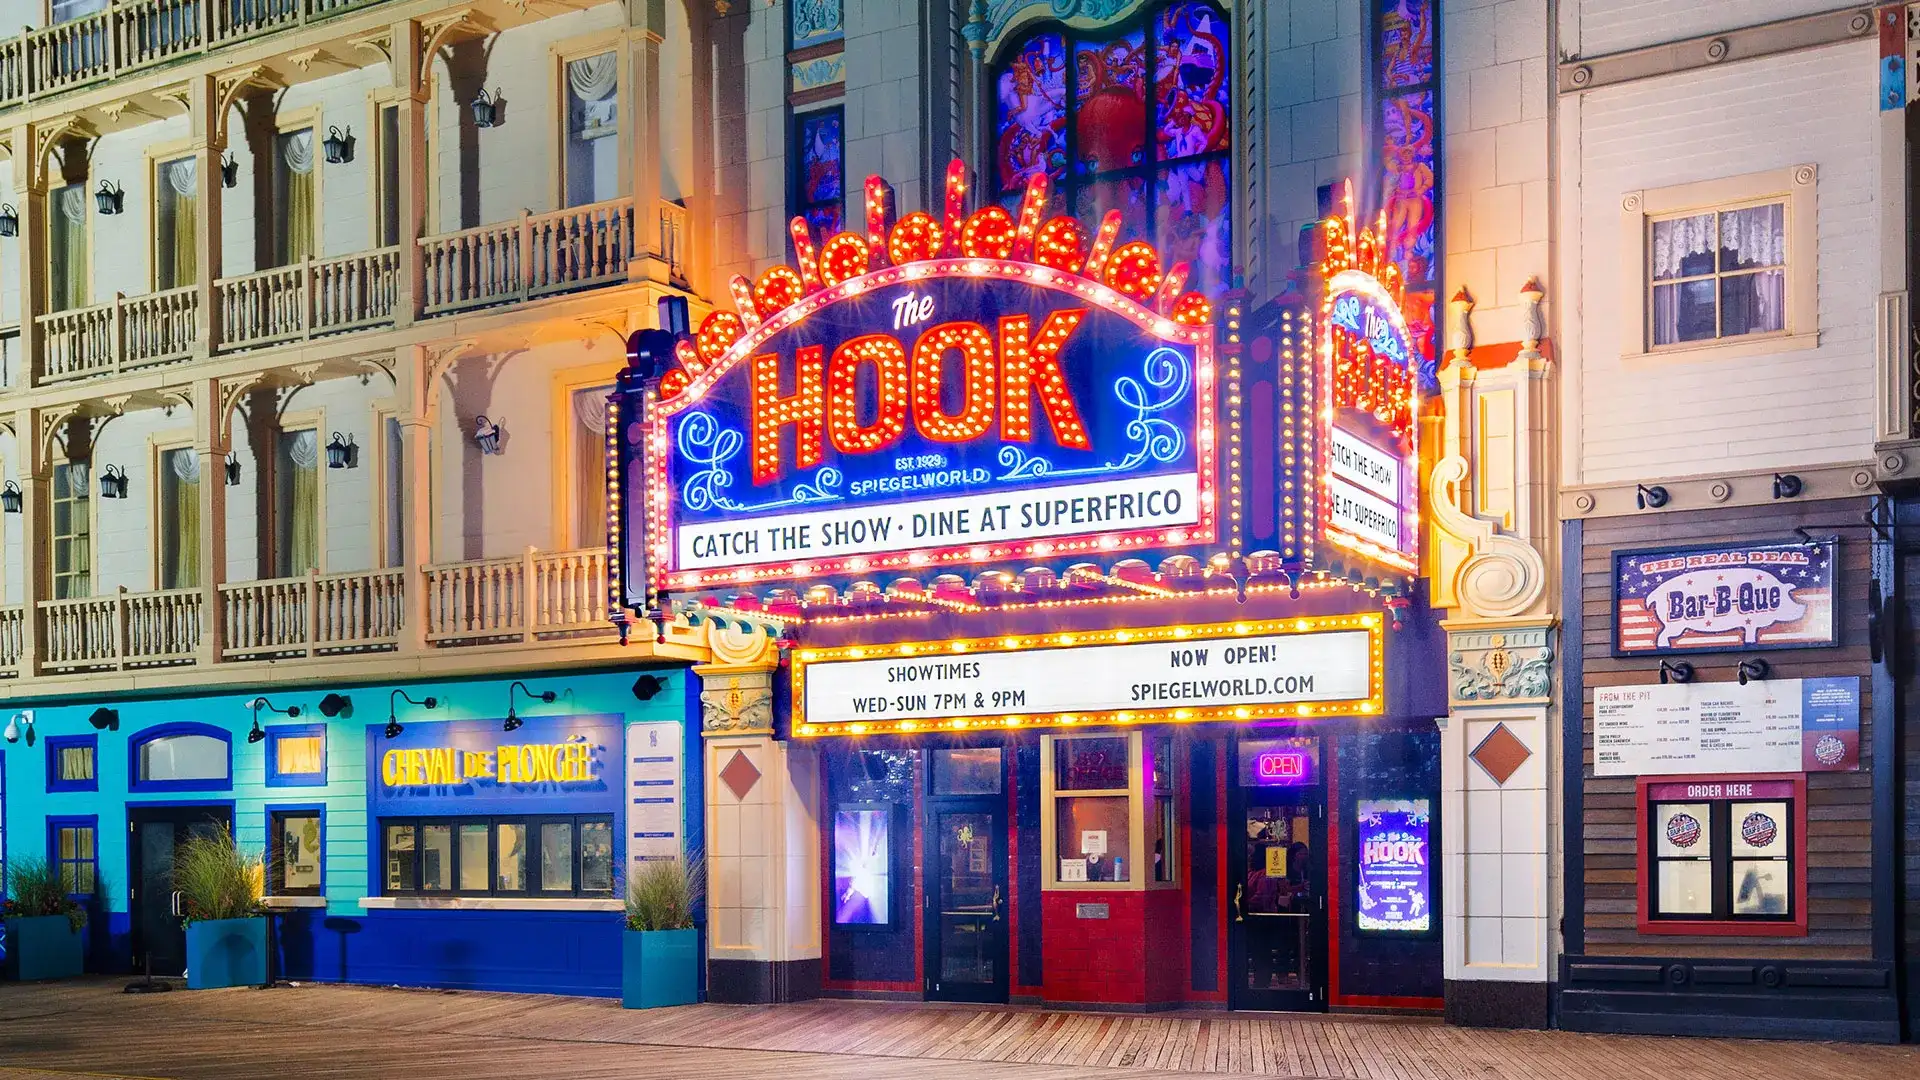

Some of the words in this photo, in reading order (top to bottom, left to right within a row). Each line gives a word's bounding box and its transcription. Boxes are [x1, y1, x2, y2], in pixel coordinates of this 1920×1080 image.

[891, 290, 935, 331] The
[1365, 305, 1384, 340] The
[751, 307, 1092, 487] HOOK
[895, 457, 914, 470] EST.
[916, 454, 943, 469] 1929
[1353, 451, 1368, 476] THE
[1370, 460, 1392, 486] SHOW
[850, 469, 985, 495] SPIEGELWORLD
[692, 525, 760, 559] CATCH
[767, 522, 811, 552] THE
[821, 516, 891, 548] SHOW
[912, 508, 969, 539] DINE
[981, 503, 1010, 533] AT
[1021, 488, 1183, 528] SUPERFRICO
[1342, 498, 1352, 519] AT
[1354, 503, 1397, 539] SUPERFRICO
[1642, 558, 1684, 575] THE
[1686, 552, 1746, 569] REAL
[1748, 550, 1809, 566] DEAL
[1667, 582, 1782, 621] Bar-B-Que
[1170, 648, 1209, 669] NOW
[1224, 645, 1278, 666] OPEN!
[887, 661, 981, 683] SHOWTIMES
[852, 692, 928, 715] WED-SUN
[933, 690, 968, 712] 7PM
[973, 691, 986, 710] &
[991, 688, 1027, 709] 9PM
[1130, 674, 1315, 703] SPIEGELWORLD.COM
[1599, 692, 1620, 702] FROM
[1623, 691, 1638, 701] THE
[1640, 690, 1652, 701] PIT
[381, 746, 464, 787] CHEVAL
[463, 750, 495, 779] DE
[496, 733, 598, 784] PLONGÉE
[1263, 755, 1301, 775] OPEN
[1687, 784, 1722, 798] ORDER
[1726, 783, 1753, 797] HERE
[1364, 841, 1425, 865] HOOK
